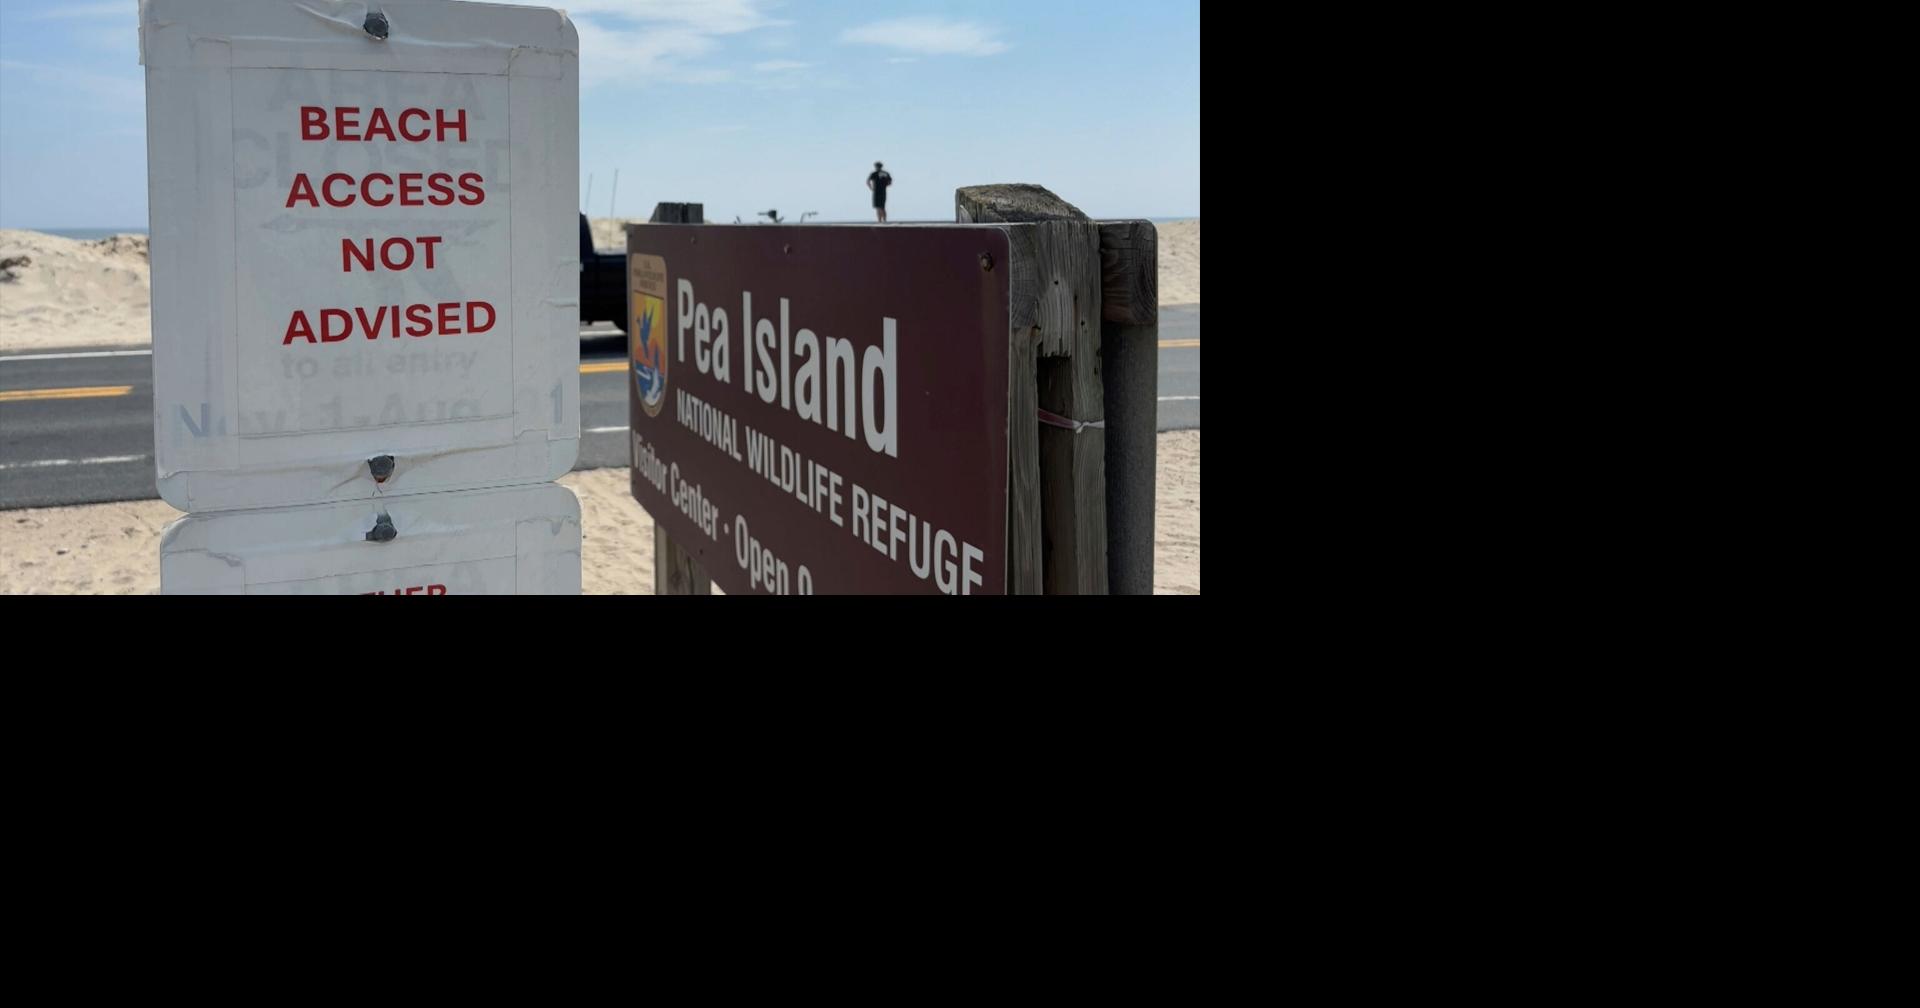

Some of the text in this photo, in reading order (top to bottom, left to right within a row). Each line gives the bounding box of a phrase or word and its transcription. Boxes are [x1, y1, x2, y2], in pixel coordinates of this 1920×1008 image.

[300, 106, 467, 142] BEACH
[286, 172, 485, 208] ACCESS
[342, 236, 440, 272] NOT
[283, 301, 496, 345] ADVISED
[677, 278, 898, 458] Pea Island
[632, 429, 668, 495] Visitor
[671, 462, 718, 541] Center
[734, 514, 789, 595] Open
[677, 388, 984, 595] NATIONAL WILDLIFE REFUGE
